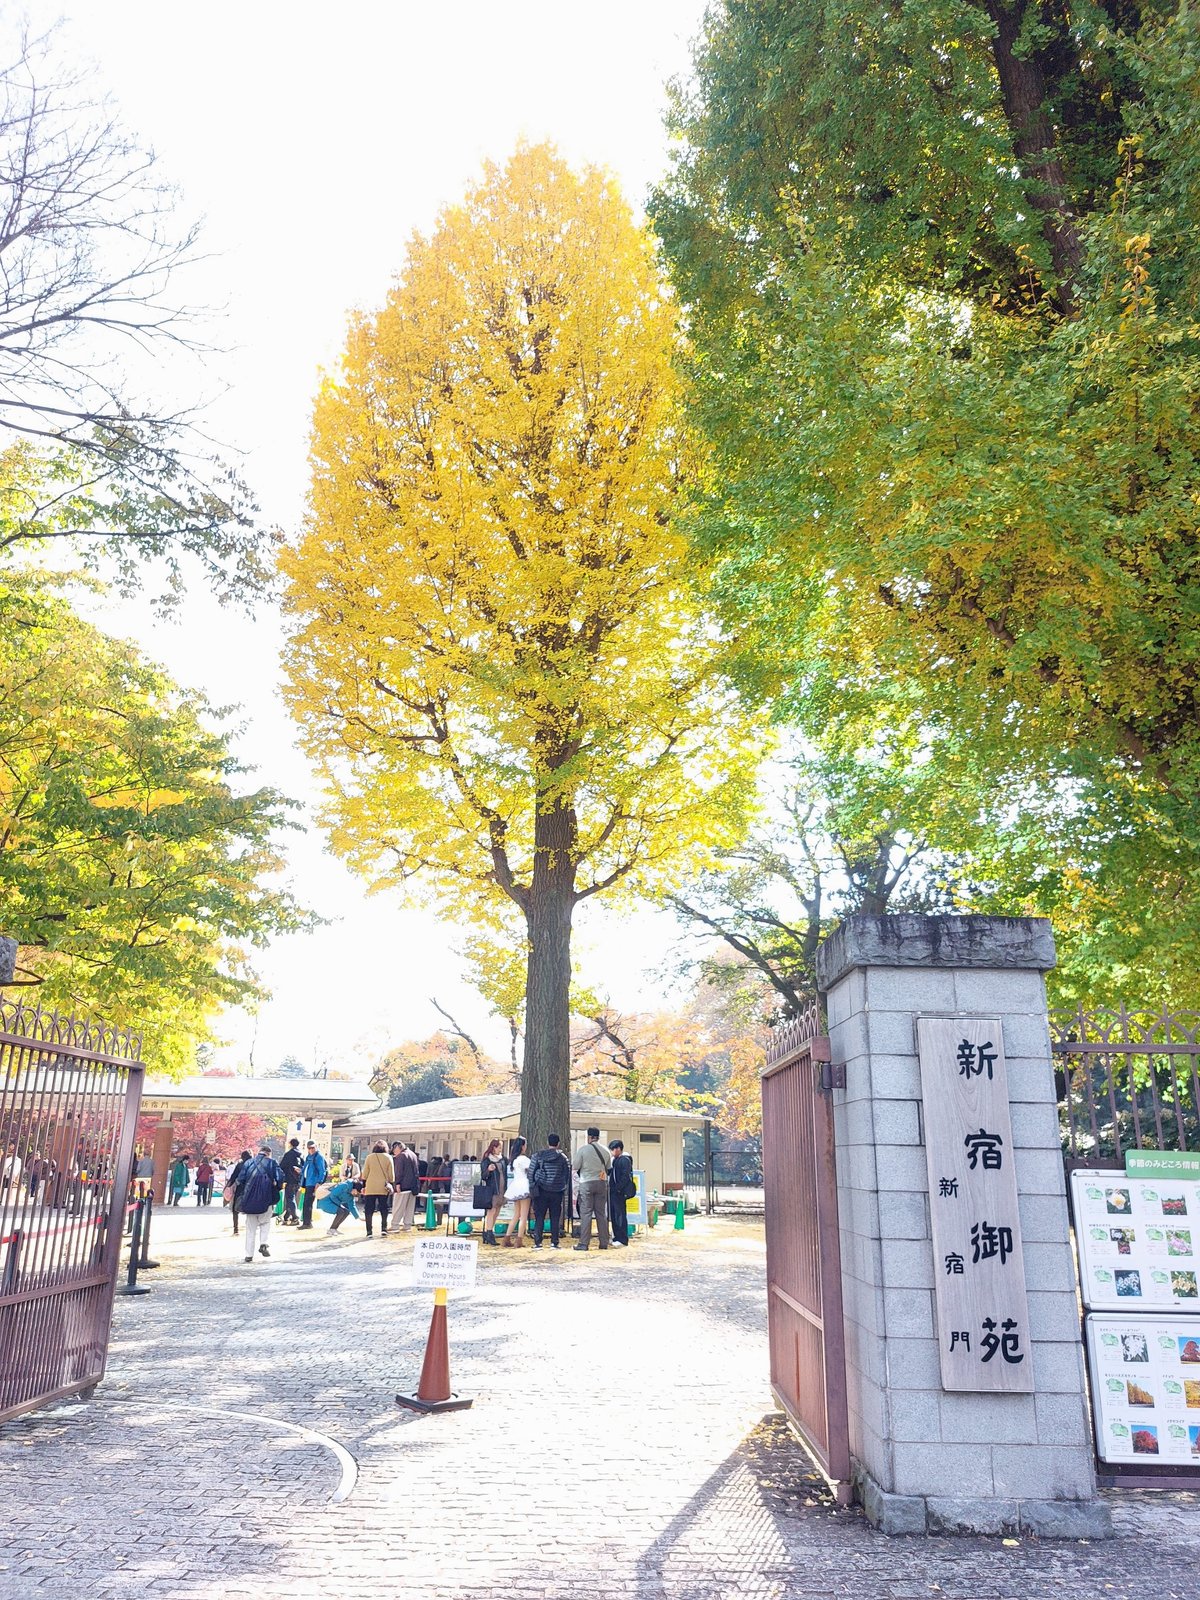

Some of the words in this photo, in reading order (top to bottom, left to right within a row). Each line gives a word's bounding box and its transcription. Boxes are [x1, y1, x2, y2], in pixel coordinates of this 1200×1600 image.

[939, 1177, 971, 1353] 新宿門
[957, 1039, 1024, 1364] 新宿御苑
